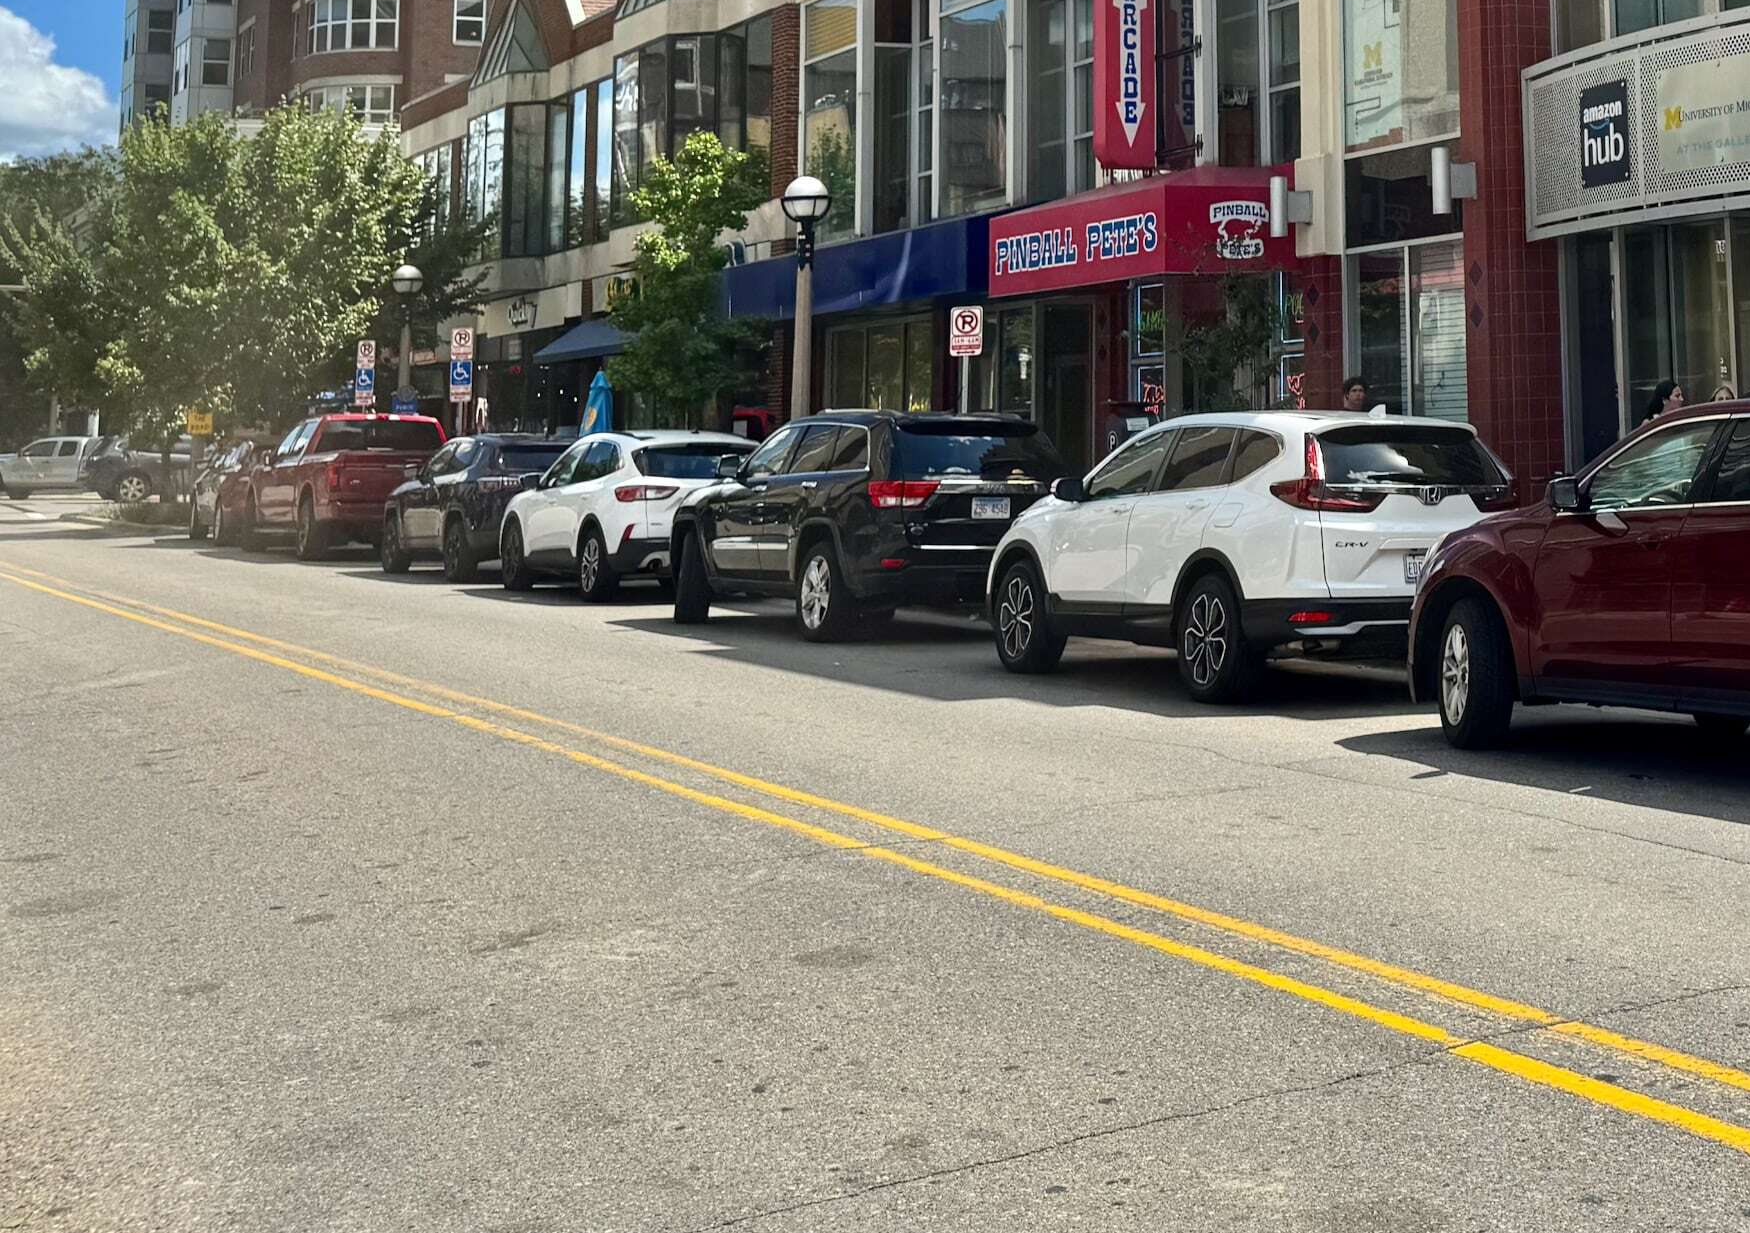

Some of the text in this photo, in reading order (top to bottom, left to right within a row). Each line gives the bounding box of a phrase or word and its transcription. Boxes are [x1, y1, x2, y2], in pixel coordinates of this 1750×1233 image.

[1583, 100, 1623, 124] amazon
[1678, 106, 1722, 122] UNIVERSITY
[1723, 104, 1734, 115] OF
[1584, 122, 1625, 167] hub
[1692, 140, 1714, 152] THE
[1213, 203, 1266, 219] PINBALL
[995, 212, 1157, 275] PINBALL PETE'S
